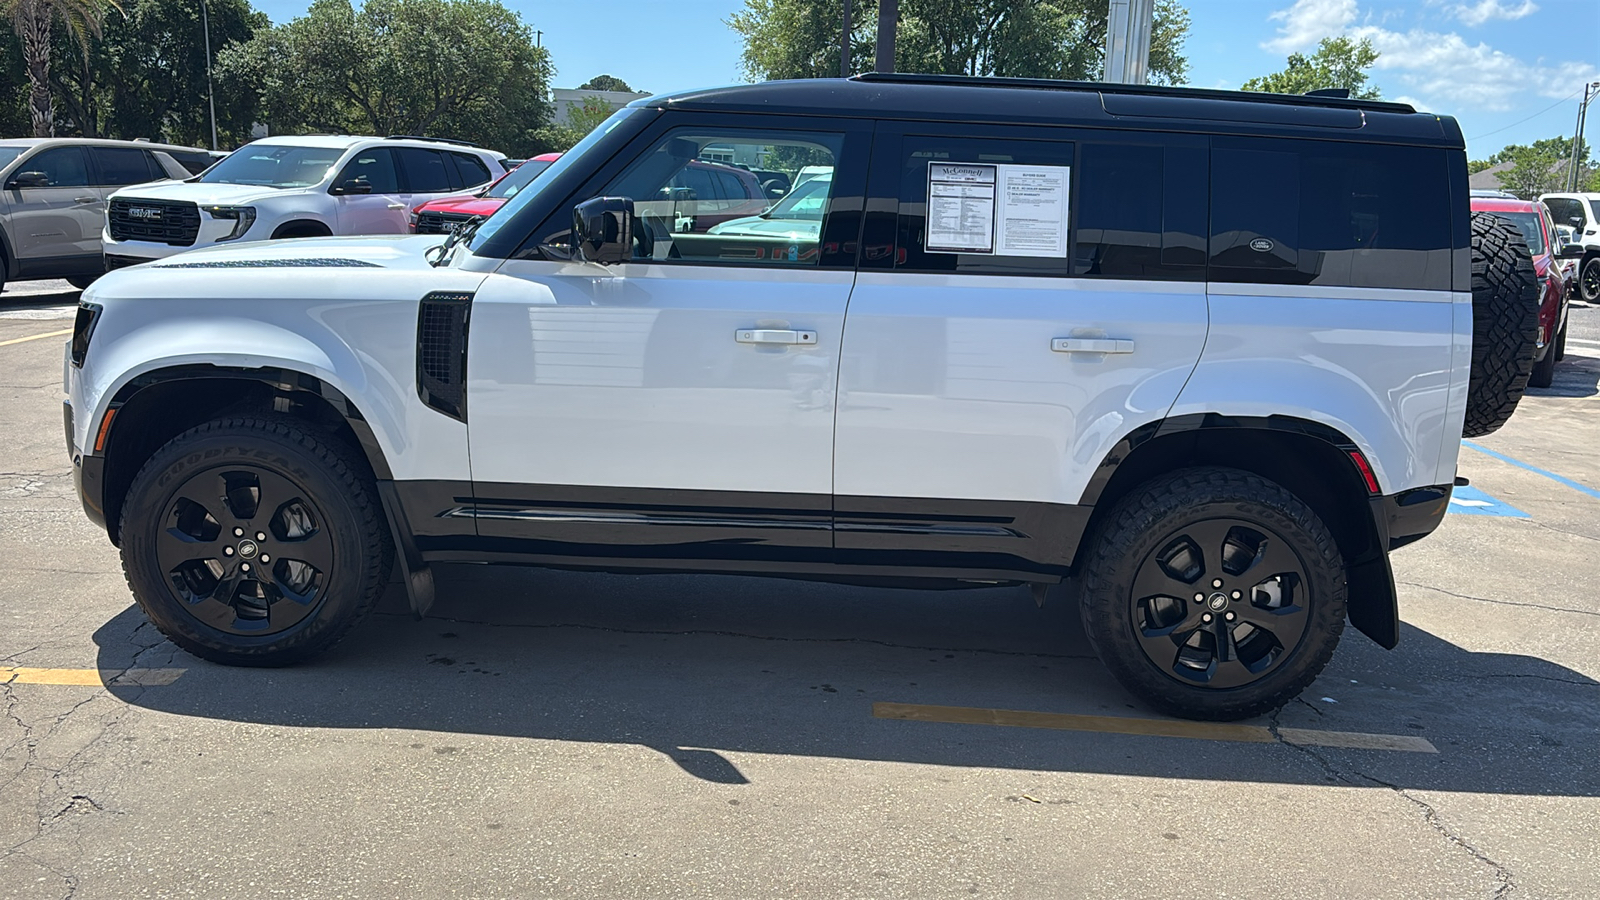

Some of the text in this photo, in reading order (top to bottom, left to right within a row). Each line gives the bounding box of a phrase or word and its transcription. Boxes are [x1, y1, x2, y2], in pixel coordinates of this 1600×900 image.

[942, 167, 983, 177] McConnell
[128, 208, 161, 219] GMC
[158, 446, 311, 487] GOODYEAR
